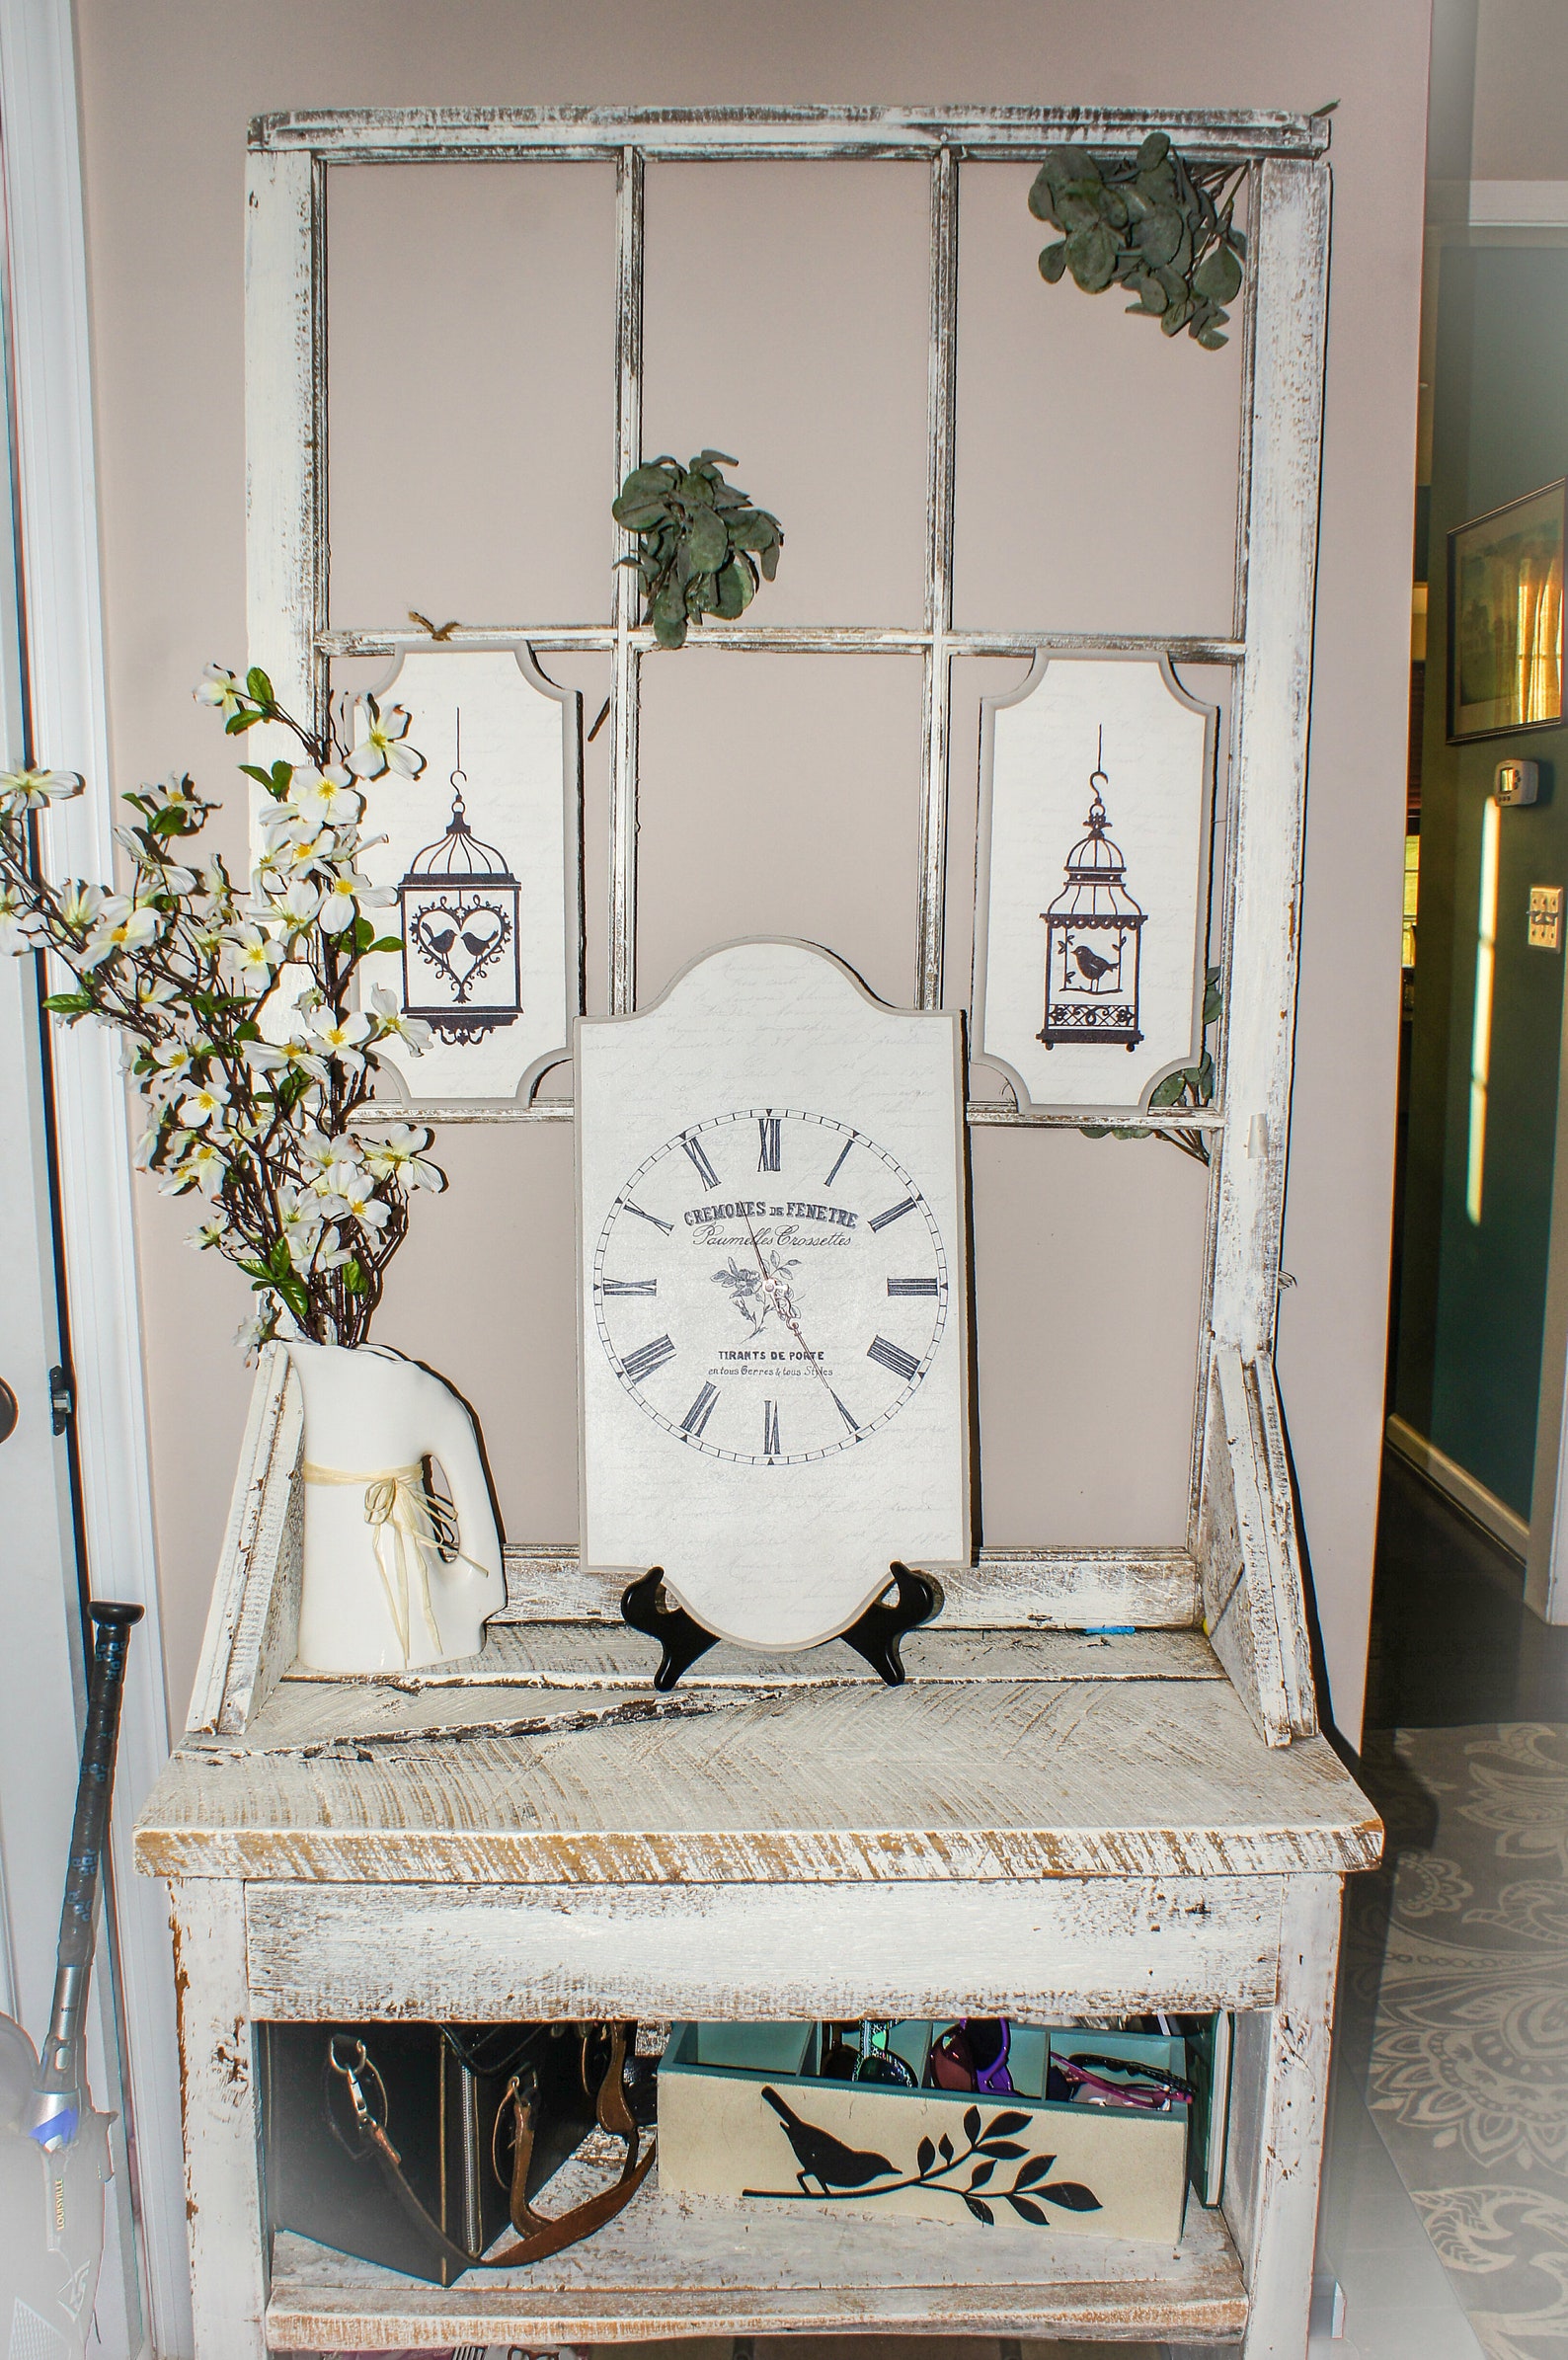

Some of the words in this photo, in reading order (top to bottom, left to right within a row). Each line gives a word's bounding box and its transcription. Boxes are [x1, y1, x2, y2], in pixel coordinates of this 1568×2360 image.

[683, 1201, 766, 1226] CREMONES
[786, 1202, 859, 1229] FENETRE
[775, 1223, 852, 1246] Crossettes
[718, 1351, 766, 1361] TIRANTS
[770, 1351, 786, 1361] DE
[789, 1351, 824, 1361] PORTE
[55, 2178, 64, 2232] LOUISVILLE
